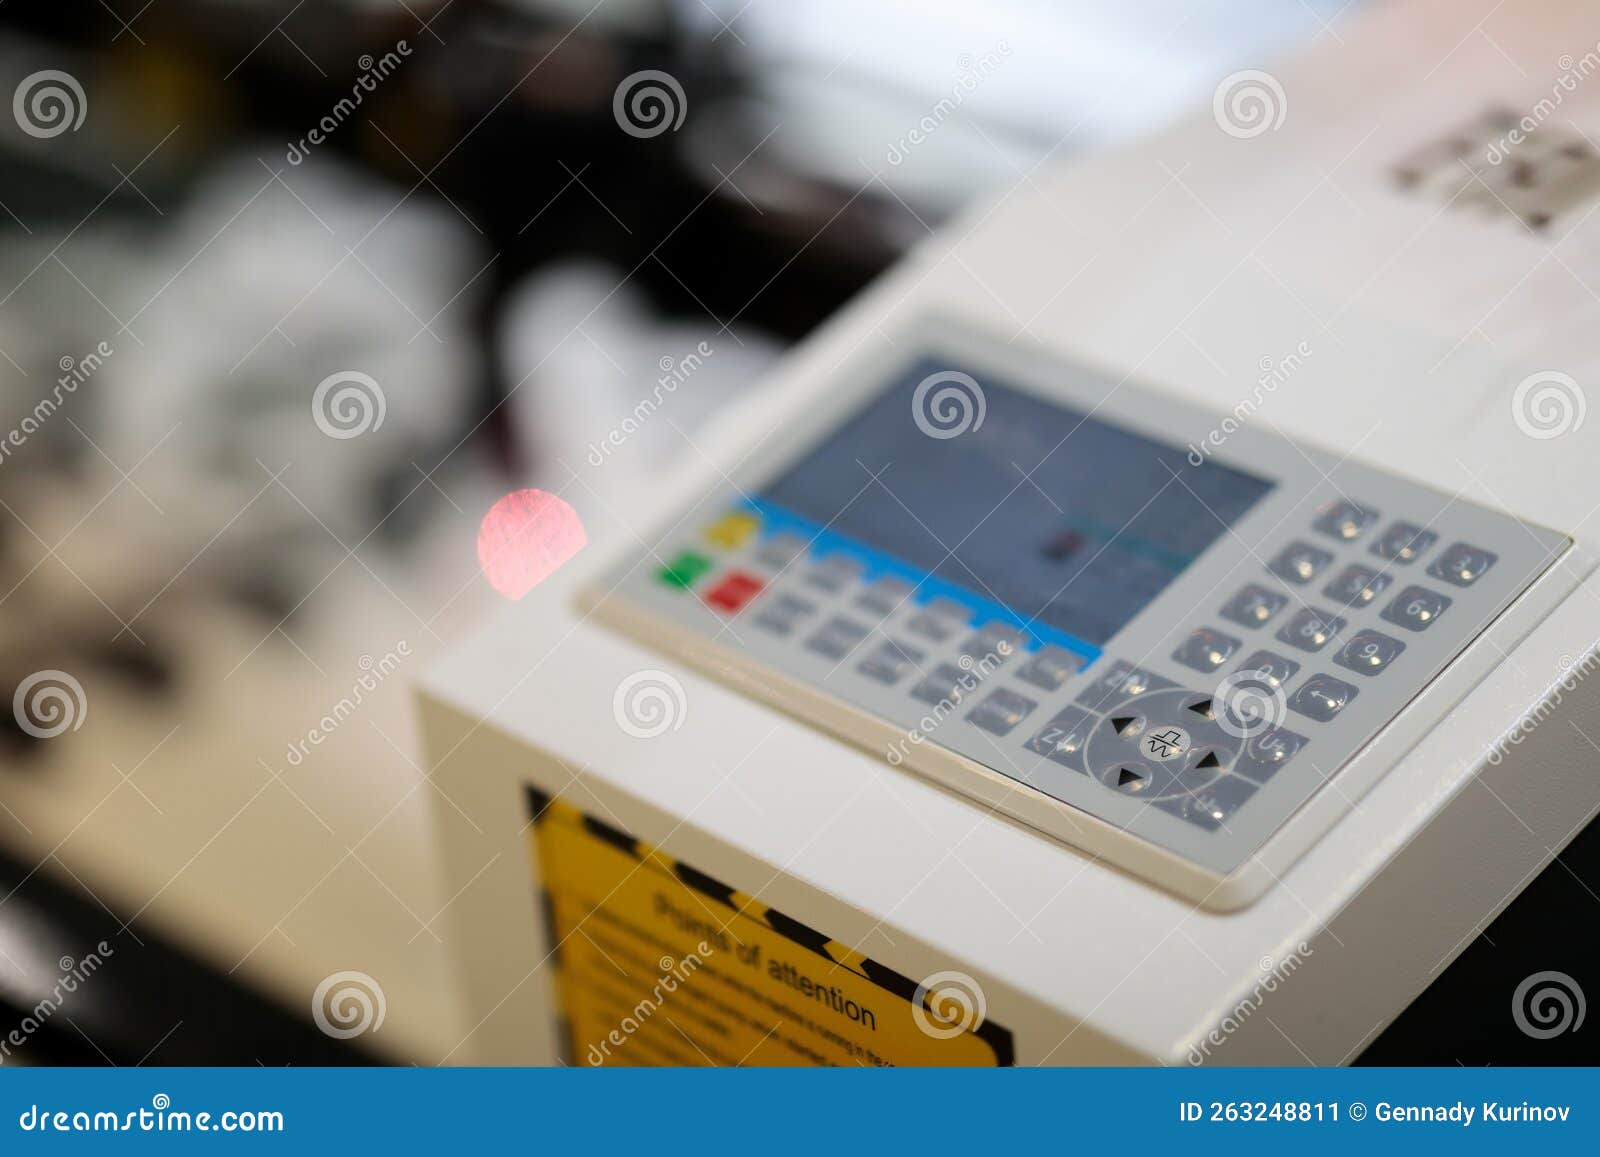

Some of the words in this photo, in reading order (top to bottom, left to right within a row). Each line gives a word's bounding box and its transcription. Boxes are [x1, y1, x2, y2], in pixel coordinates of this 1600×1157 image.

[1358, 643, 1379, 659] 9
[736, 942, 761, 970] of
[768, 958, 876, 1032] attention
